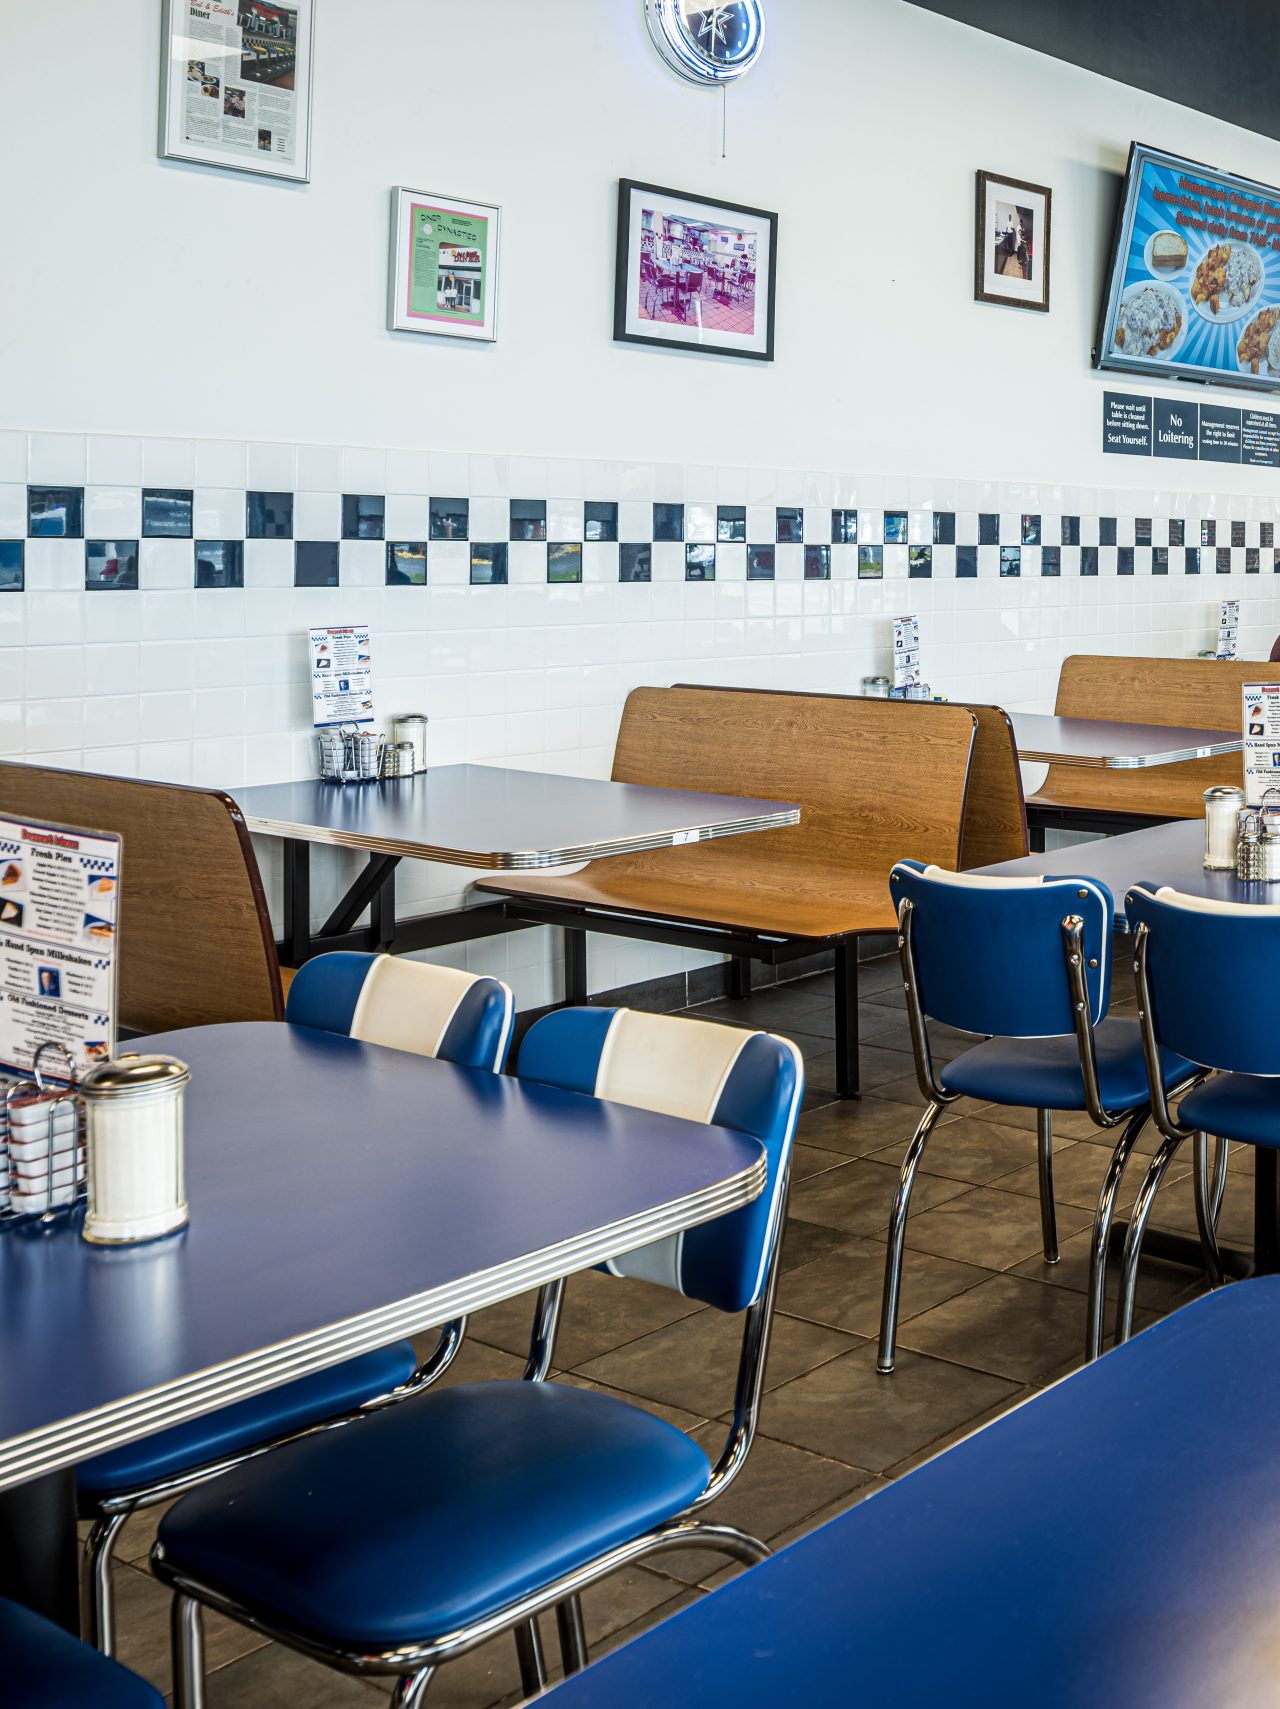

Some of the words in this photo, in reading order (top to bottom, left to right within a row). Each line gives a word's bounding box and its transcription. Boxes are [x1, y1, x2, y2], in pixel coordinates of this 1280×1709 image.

[190, 7, 210, 19] Diner
[1179, 176, 1227, 200] Homemade
[1153, 186, 1178, 205] home
[1204, 201, 1224, 218] hash
[1257, 219, 1266, 229] or
[1176, 211, 1207, 231] Served
[1208, 219, 1228, 239] daily
[1229, 225, 1248, 241] from
[1110, 401, 1124, 410] Please
[1107, 419, 1121, 427] before
[1122, 421, 1135, 430] sitting
[1136, 422, 1149, 430] down.
[1170, 414, 1182, 426] No
[1108, 433, 1121, 443] Seat
[1122, 434, 1148, 446] Yourself.
[1158, 429, 1193, 449] Loitering
[1213, 430, 1221, 438] right
[31, 847, 52, 859] Fresh
[55, 852, 72, 863] Pies
[5, 940, 23, 952] Hand
[26, 944, 44, 956] Spun
[47, 948, 91, 966] Milkshakes
[8, 994, 19, 1004] Old
[22, 997, 56, 1012] Fashioned
[59, 1007, 88, 1021] Desserts
